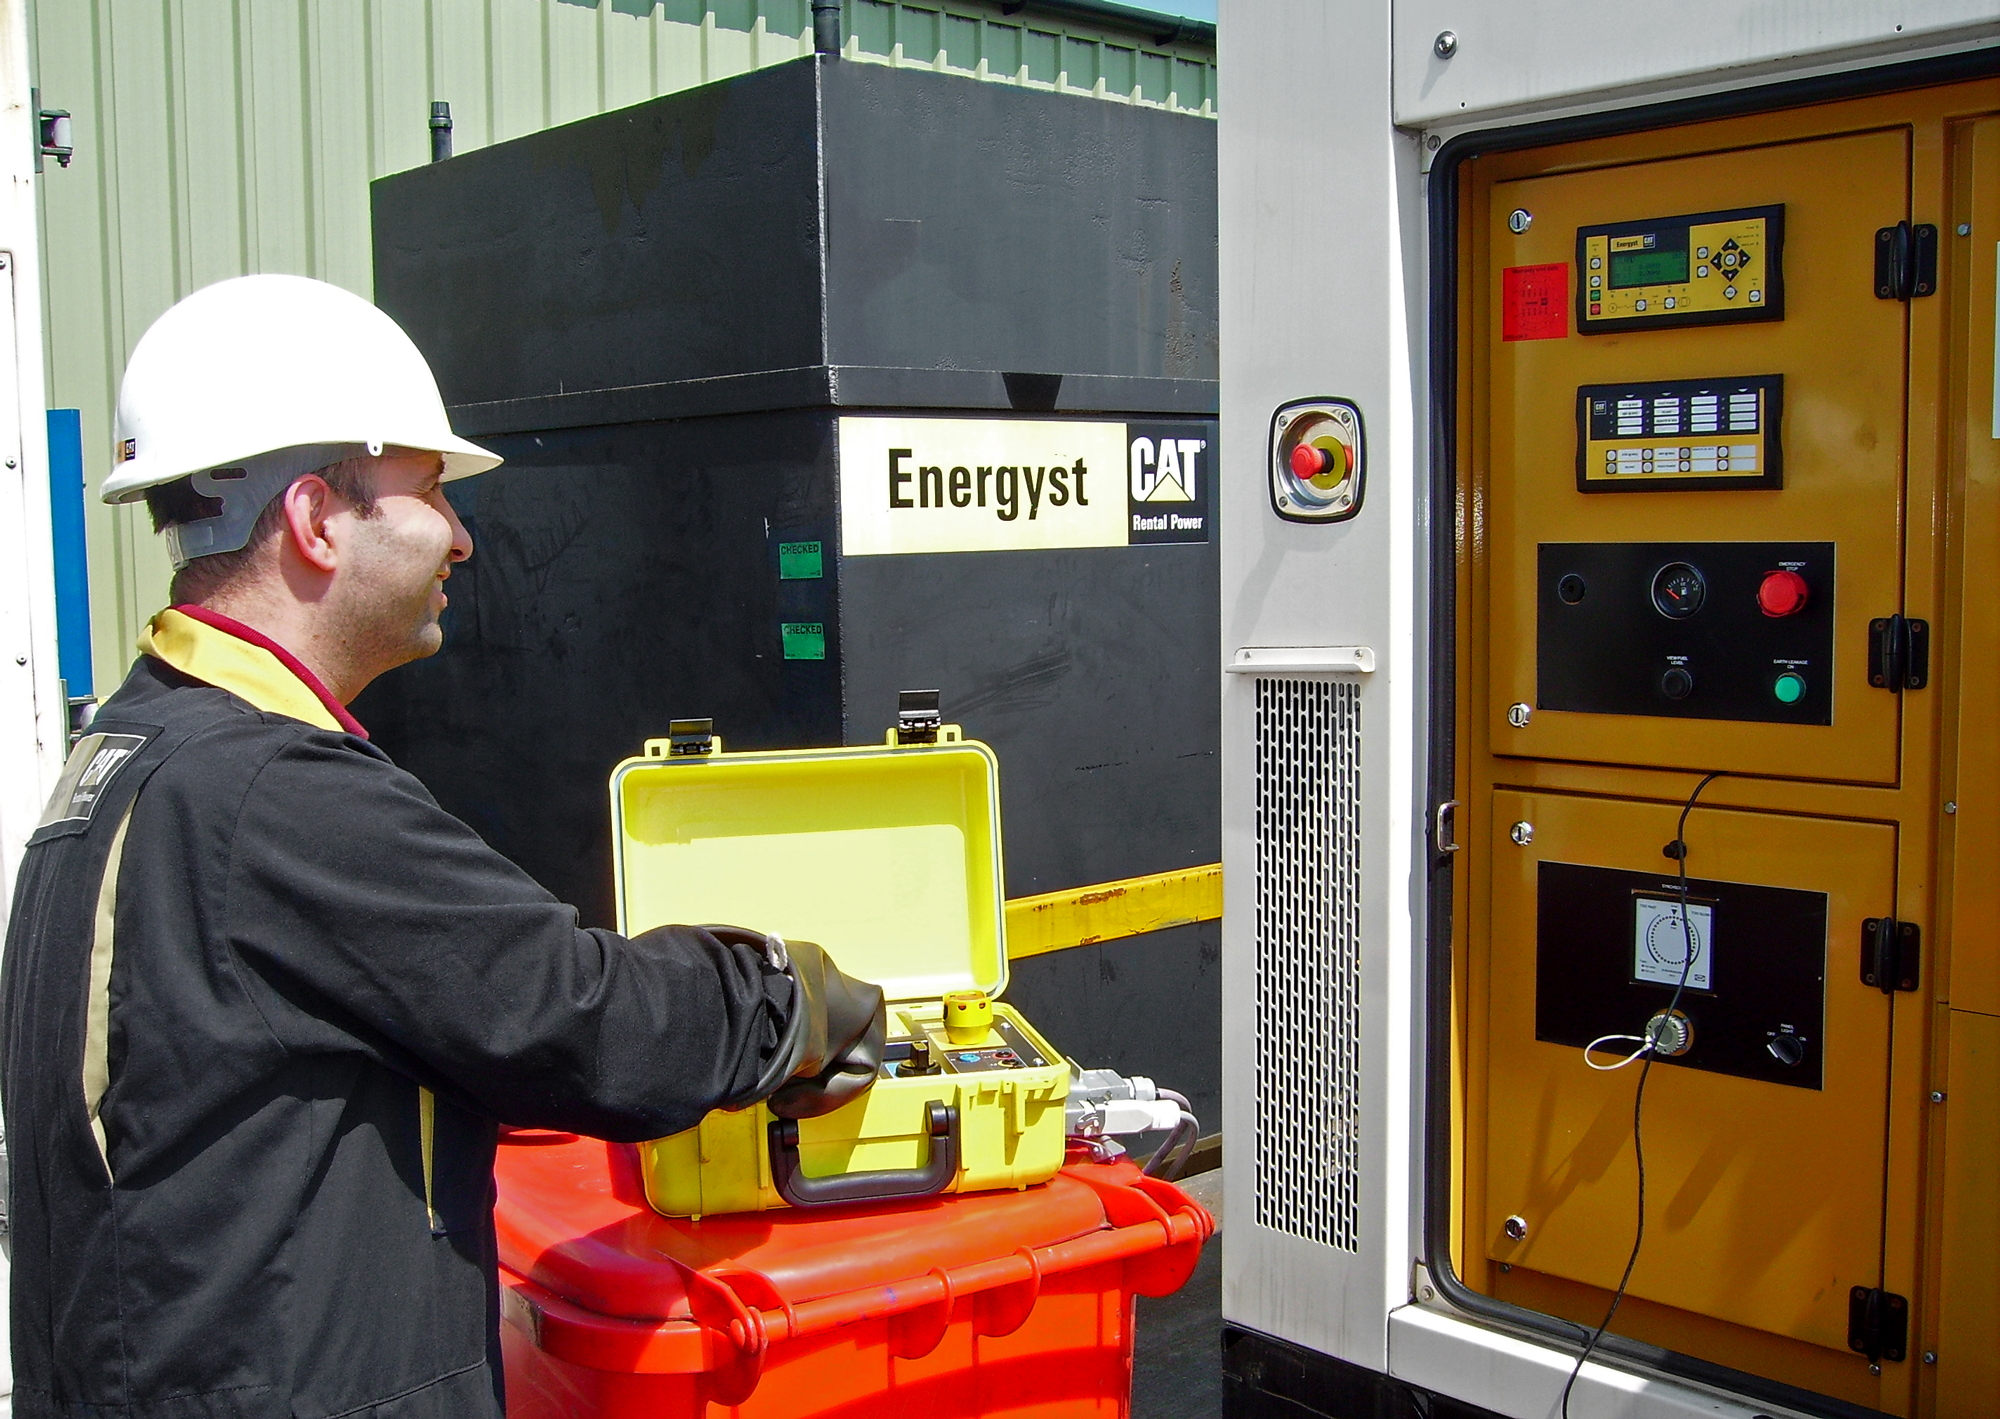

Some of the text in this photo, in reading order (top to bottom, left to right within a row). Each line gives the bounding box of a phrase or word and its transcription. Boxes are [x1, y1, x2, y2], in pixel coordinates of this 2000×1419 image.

[1616, 236, 1654, 248] Energyst CAT
[888, 436, 1201, 521] Energyst CAT
[1132, 513, 1203, 531] Rental Power
[781, 544, 819, 555] CHECKED
[784, 625, 822, 635] CHECKED
[79, 748, 129, 787] CAT
